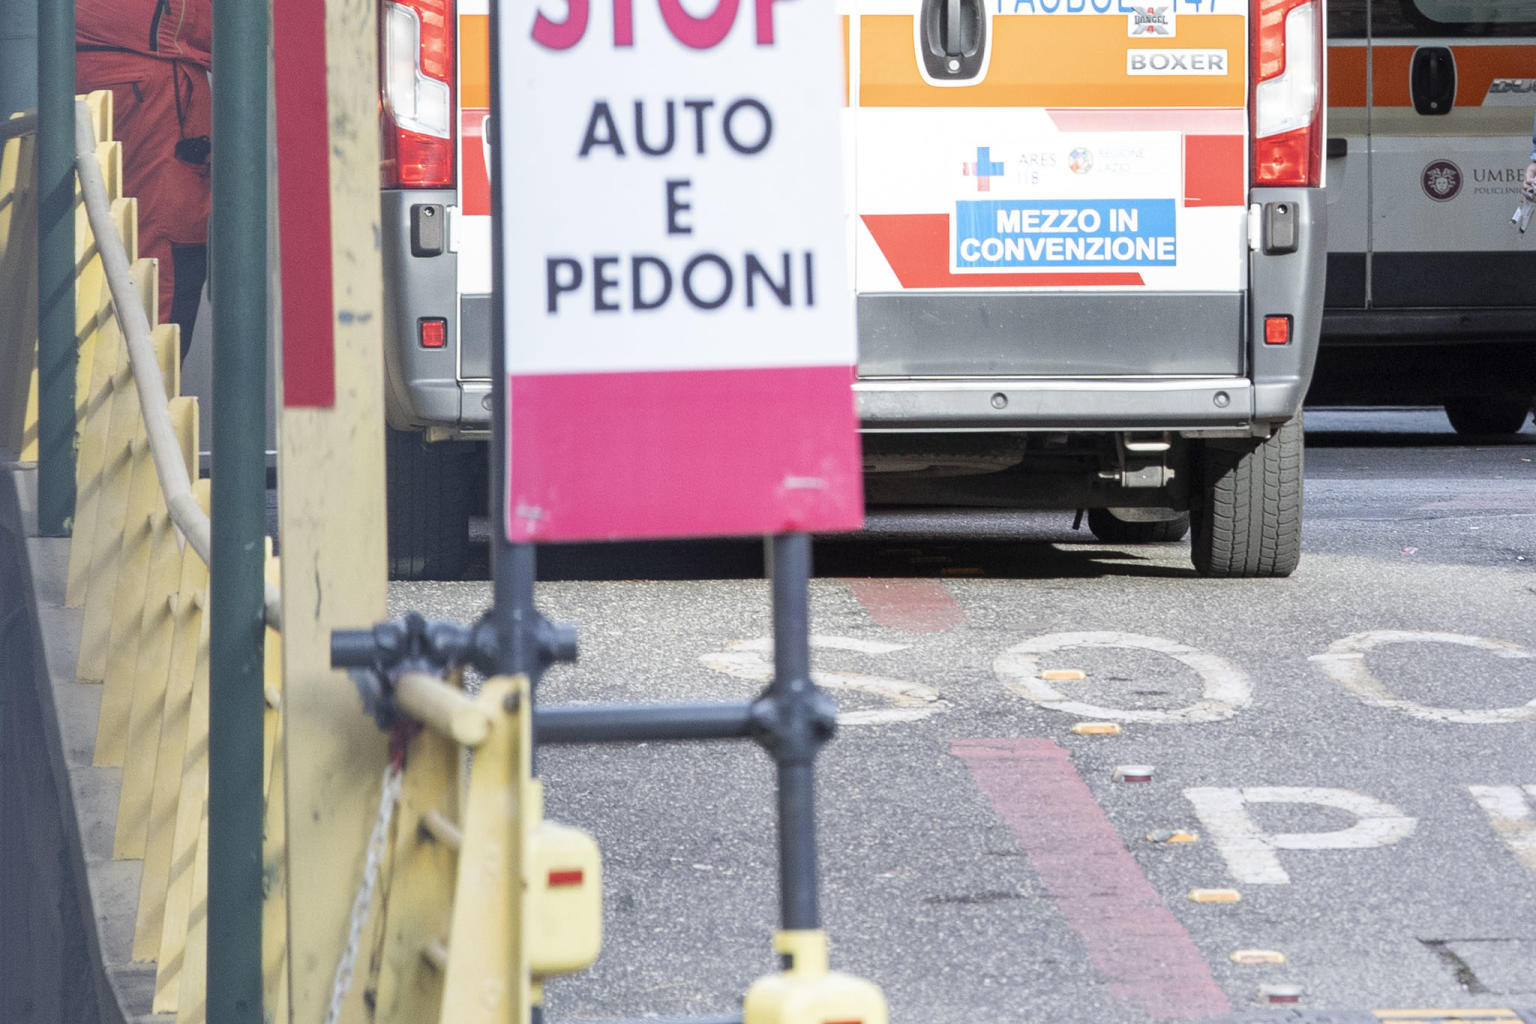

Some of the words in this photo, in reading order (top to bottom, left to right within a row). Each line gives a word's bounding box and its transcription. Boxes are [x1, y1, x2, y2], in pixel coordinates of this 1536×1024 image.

[1131, 54, 1223, 70] BOXER
[578, 98, 773, 157] AUTO
[665, 179, 693, 235] E
[996, 209, 1100, 233] MEZZO
[1109, 208, 1139, 233] IN
[960, 237, 1176, 262] CONVENZIONE
[546, 252, 815, 314] PEDONI
